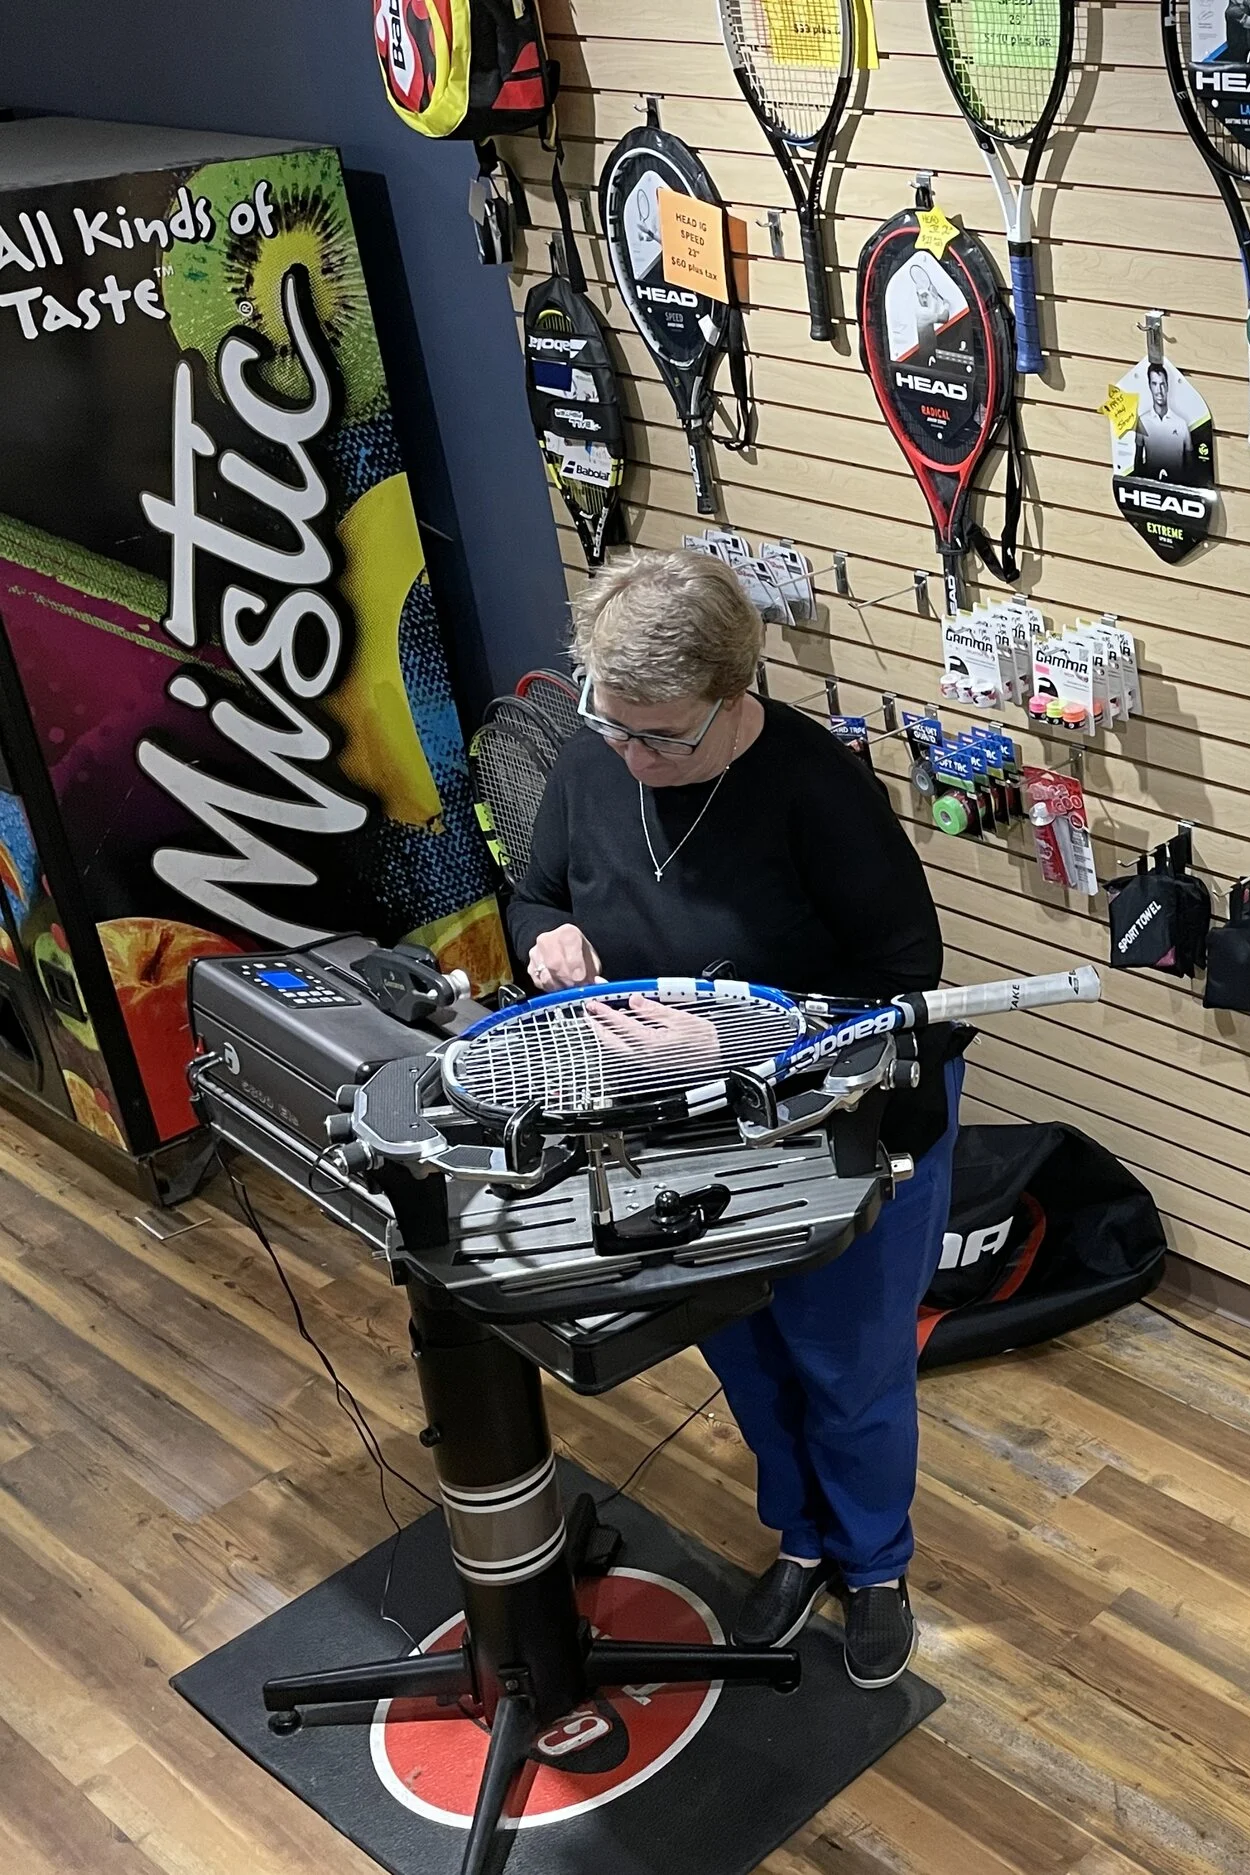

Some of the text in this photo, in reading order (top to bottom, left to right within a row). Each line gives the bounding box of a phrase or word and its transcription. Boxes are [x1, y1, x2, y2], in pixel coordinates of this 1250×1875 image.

[0, 181, 274, 272] All Kinds of
[676, 212, 697, 230] HEAD
[680, 229, 706, 247] SPEED
[671, 256, 718, 281] $60 plus tax
[0, 274, 166, 340] Taste
[636, 285, 699, 308] HEAD
[664, 311, 684, 323] SPEED
[896, 371, 969, 402] HEAD
[920, 404, 951, 421] RADICAL
[576, 465, 611, 481] Babolat
[1118, 487, 1206, 519] HEAD
[1146, 521, 1184, 541] EXTREME
[136, 273, 370, 945] Mistic
[945, 626, 993, 654] GAMMA
[1035, 648, 1089, 675] GAMMA
[1117, 900, 1162, 954] SPORT TOWEL
